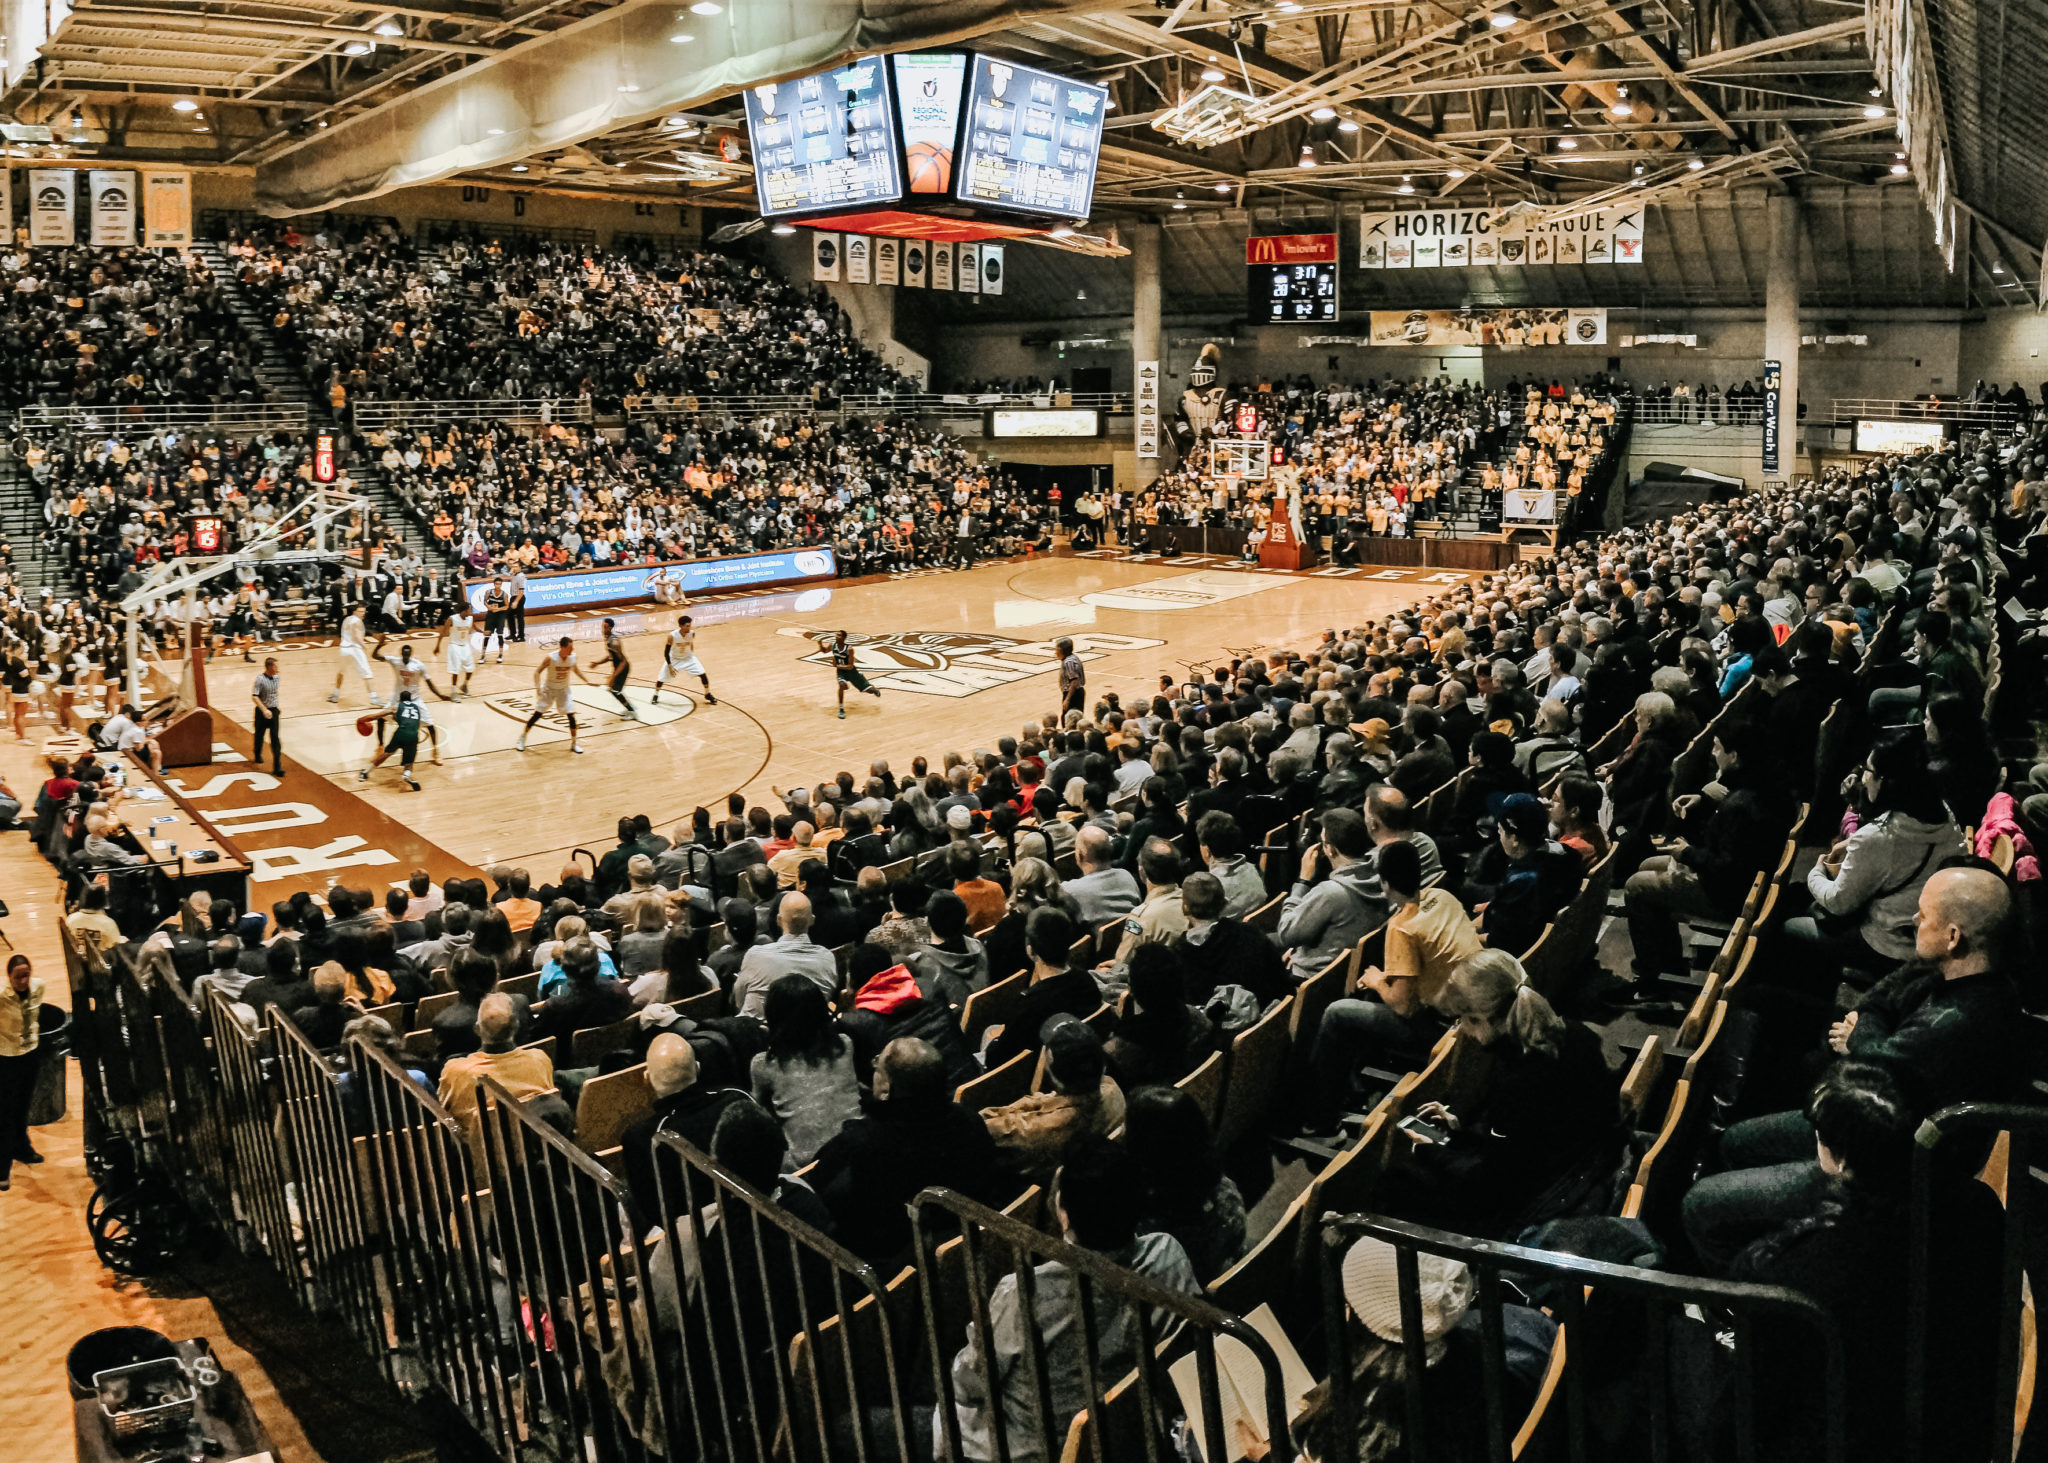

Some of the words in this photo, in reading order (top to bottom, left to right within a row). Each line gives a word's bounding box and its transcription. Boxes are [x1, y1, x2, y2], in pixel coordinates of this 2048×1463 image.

[1395, 211, 1491, 237] HORIZO
[585, 579, 590, 587] &
[592, 578, 608, 586] Joint
[575, 589, 593, 597] Team
[401, 706, 419, 720] 45
